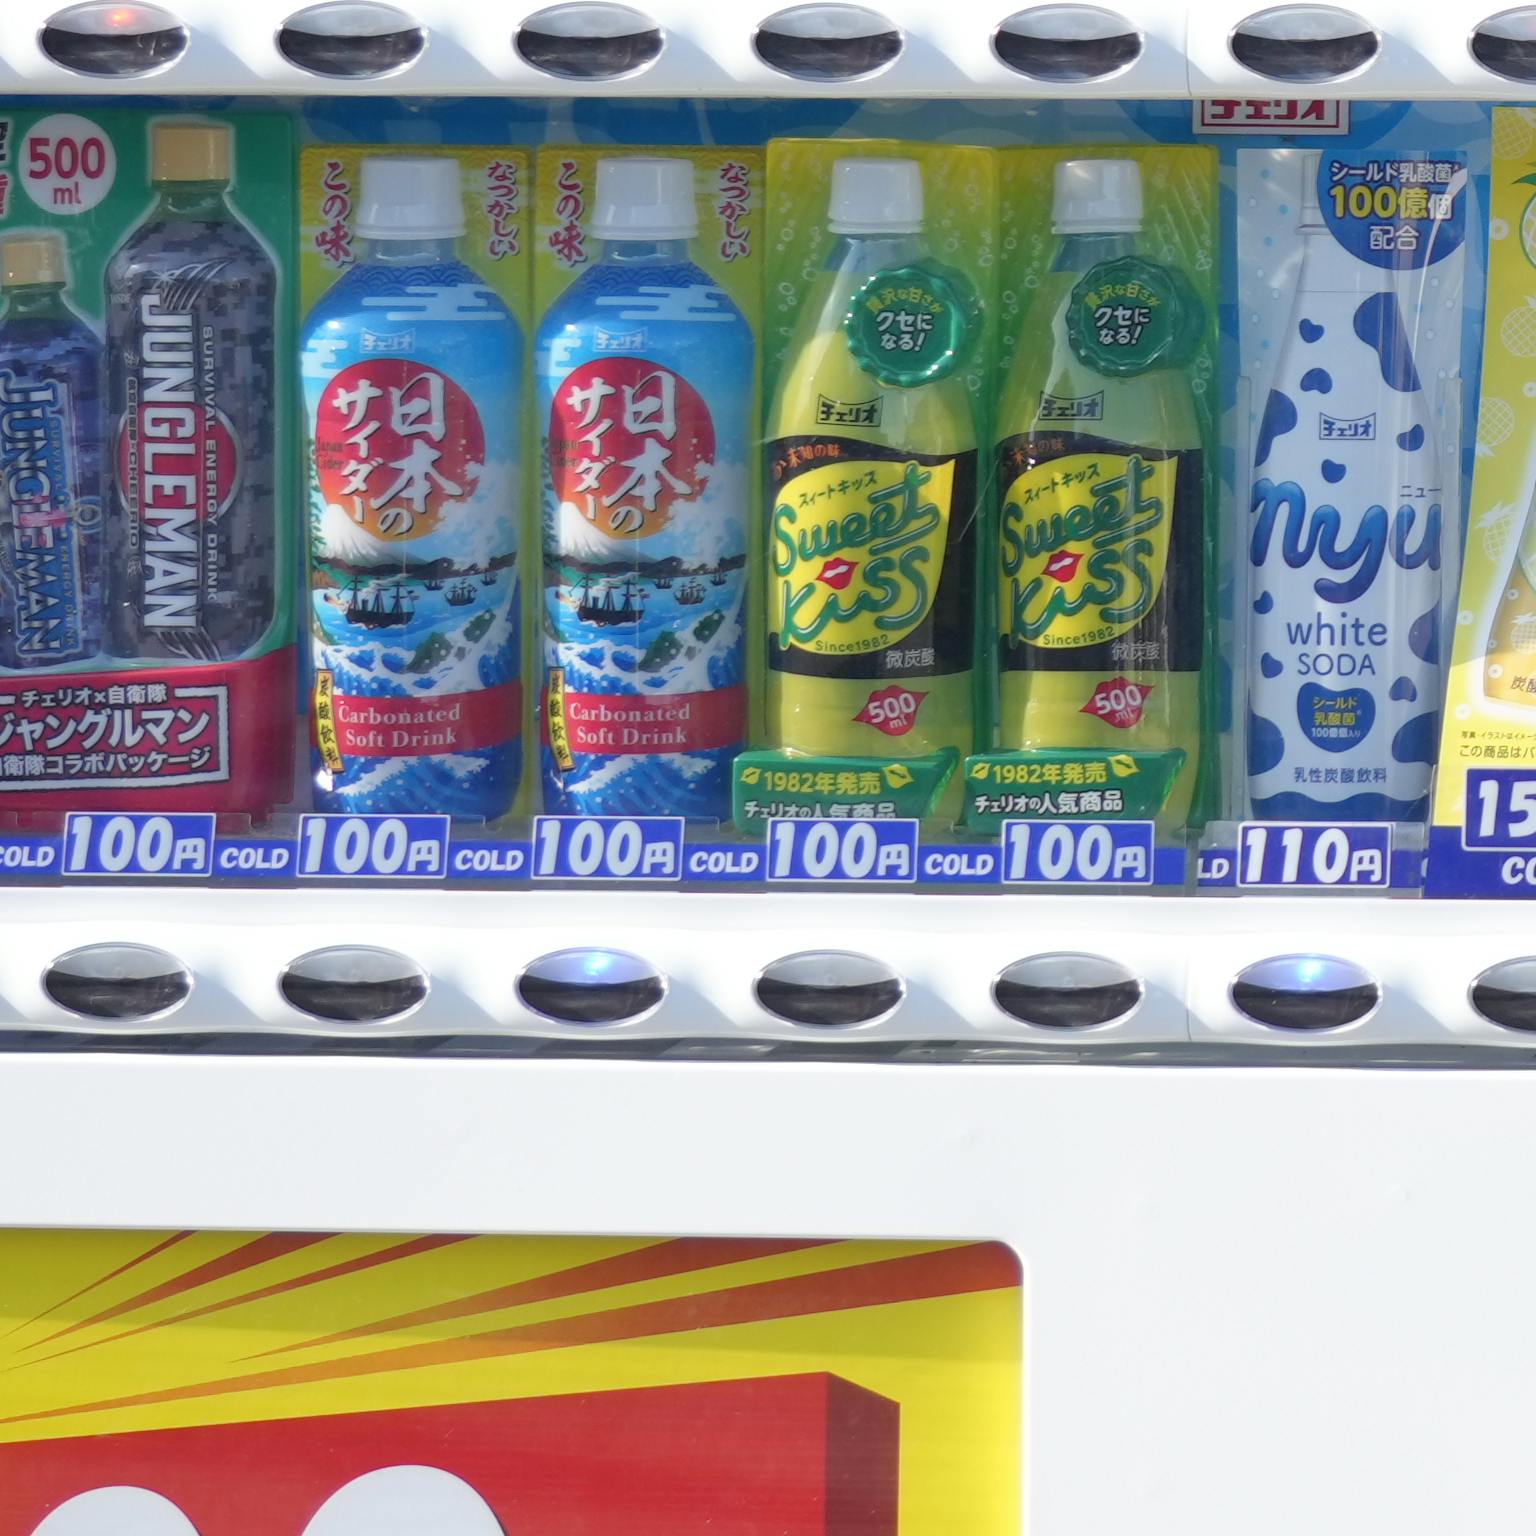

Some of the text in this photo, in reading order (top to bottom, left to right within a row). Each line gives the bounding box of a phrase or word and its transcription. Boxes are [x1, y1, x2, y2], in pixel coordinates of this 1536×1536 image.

[27, 137, 106, 181] 500
[53, 181, 82, 205] ml
[315, 161, 352, 264] この味
[485, 161, 519, 260] なつかしい
[1369, 225, 1420, 251] 配合
[139, 293, 198, 631] JUNGLEMAN
[201, 325, 218, 601] SURVIVAL ENERGY DRINK
[376, 370, 465, 539] 日本の
[773, 461, 942, 578] Sweet
[1249, 476, 1443, 605] nyu
[1286, 612, 1390, 648] white
[1297, 652, 1376, 678] SODA
[21, 683, 168, 708] チェリオ×自衛隊
[338, 700, 462, 726] Carbonated
[345, 726, 458, 748] Soft Drink
[763, 772, 883, 796] 1982年発売
[71, 816, 205, 872] 100円
[540, 820, 674, 876] 100円
[1010, 824, 1145, 881] 100円
[1246, 827, 1382, 884] 110円
